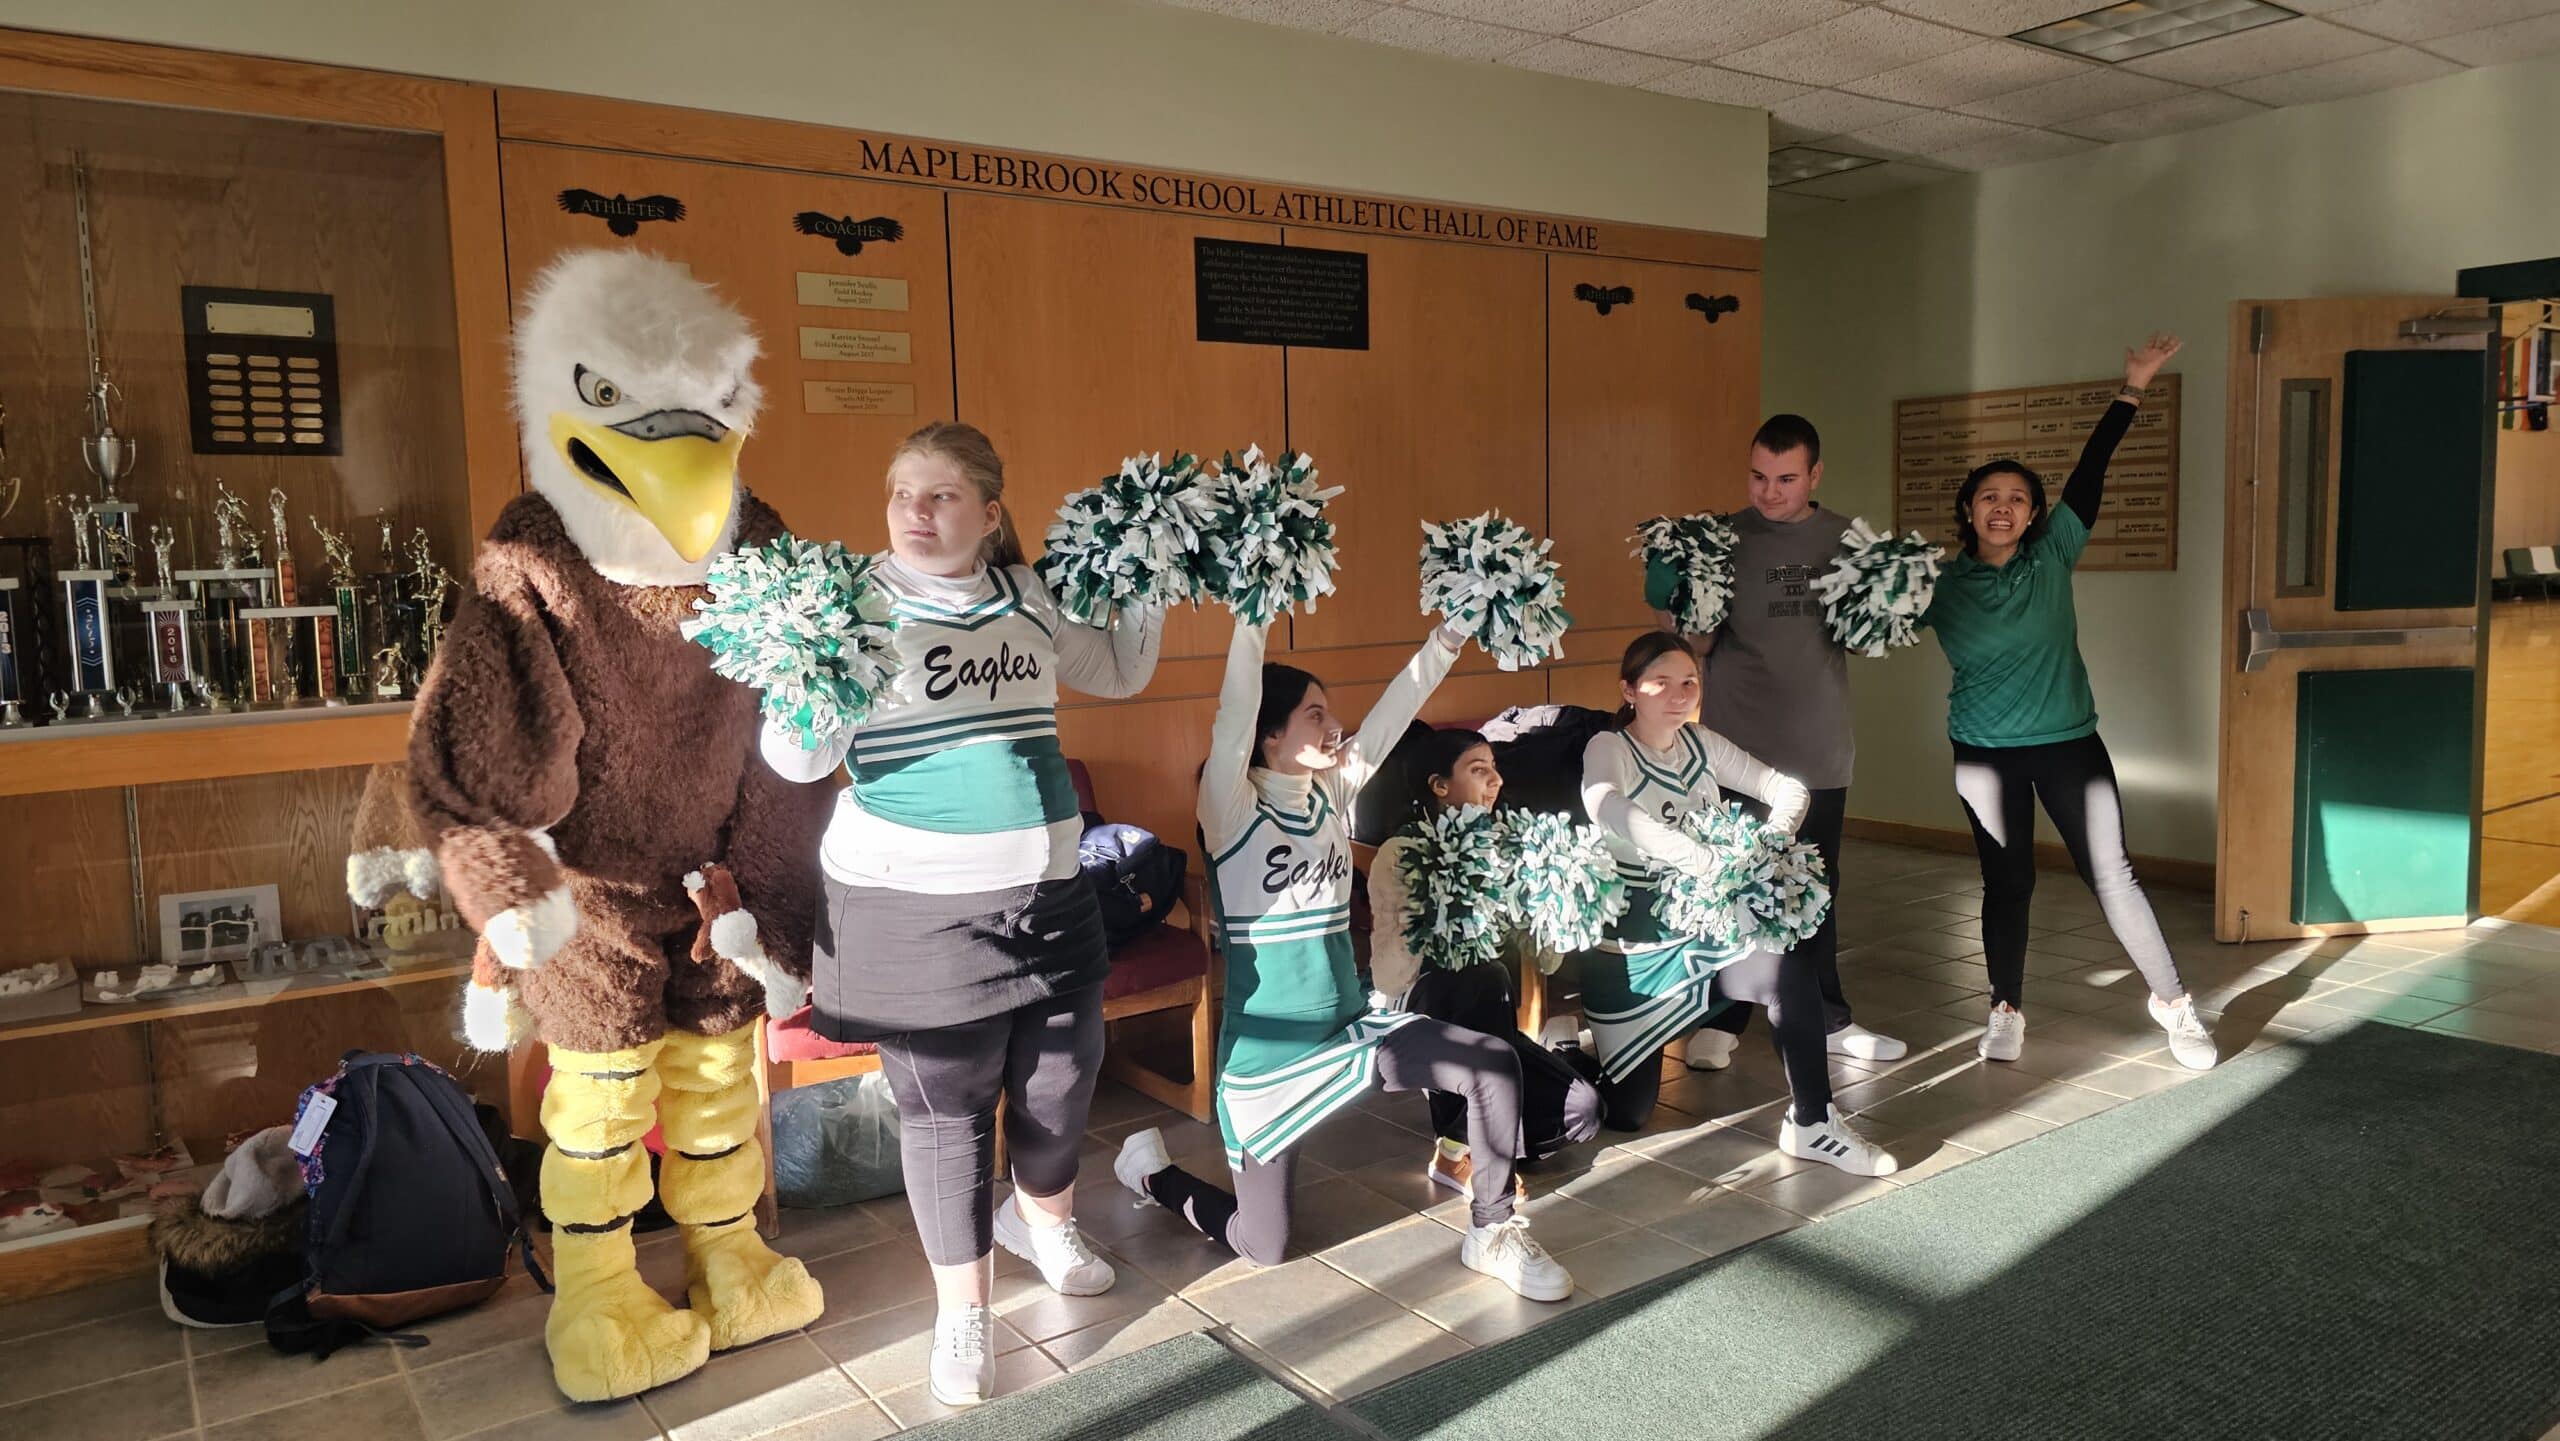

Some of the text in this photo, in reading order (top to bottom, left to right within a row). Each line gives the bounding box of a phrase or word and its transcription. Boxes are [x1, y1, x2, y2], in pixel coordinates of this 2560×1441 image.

[581, 199, 665, 218] ATHLETES
[858, 139, 1600, 251] MAPLEBROOK SCHOOL ATHLETIC HALL OF FAME
[814, 221, 884, 239] COACHES
[166, 627, 179, 665] 2016
[923, 641, 1041, 702] Eagles
[1262, 842, 1348, 900] Eagles
